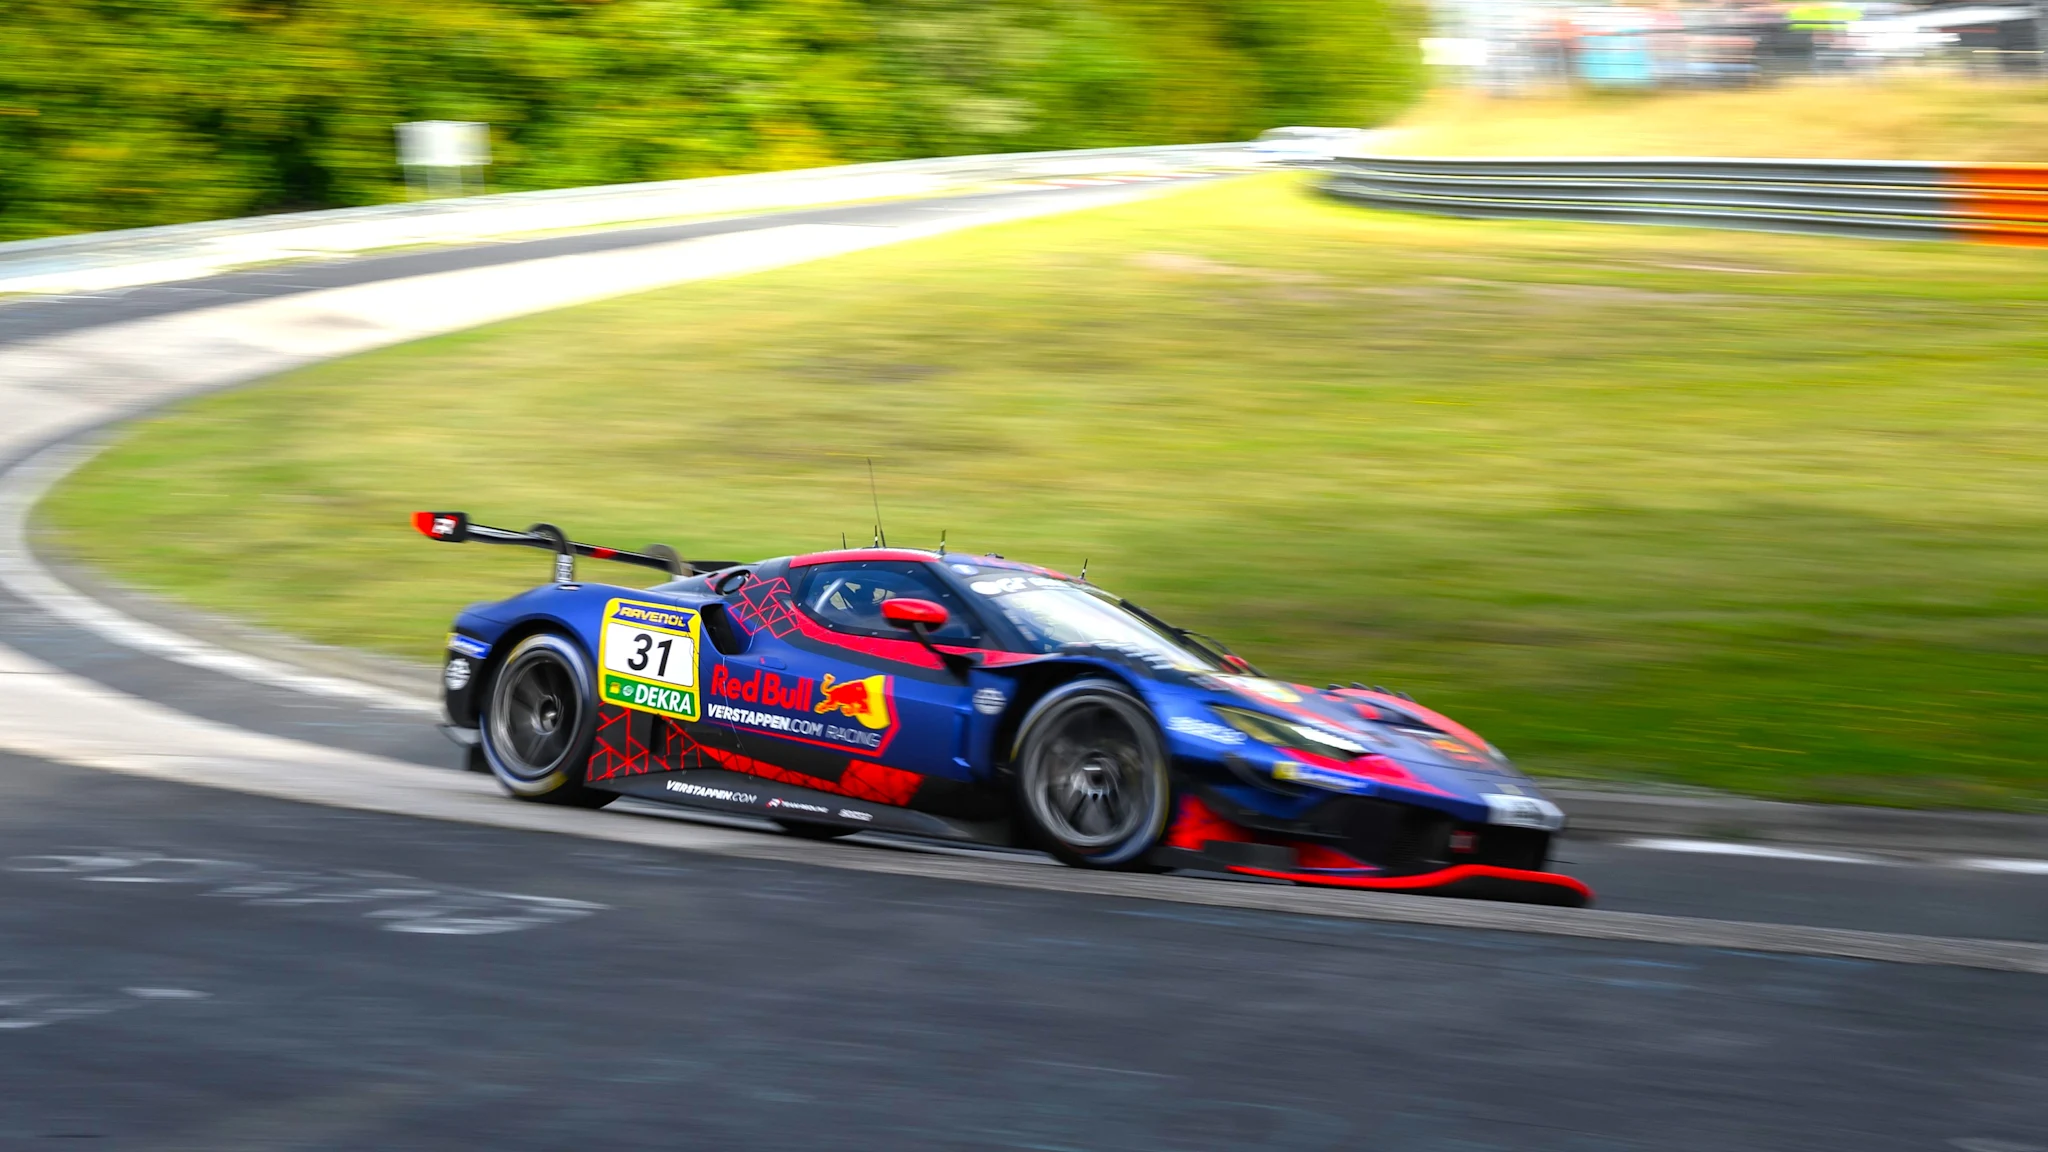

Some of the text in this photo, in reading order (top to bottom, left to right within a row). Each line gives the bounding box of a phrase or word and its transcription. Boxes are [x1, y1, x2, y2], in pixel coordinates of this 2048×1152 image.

[620, 606, 686, 627] RAVENOL
[627, 633, 673, 677] 31
[634, 683, 691, 714] DEKRA
[711, 664, 813, 712] Red Bull
[707, 703, 881, 748] VERSTAPPEN.COM RACING
[666, 780, 757, 804] VERSTAPPEN.COM
